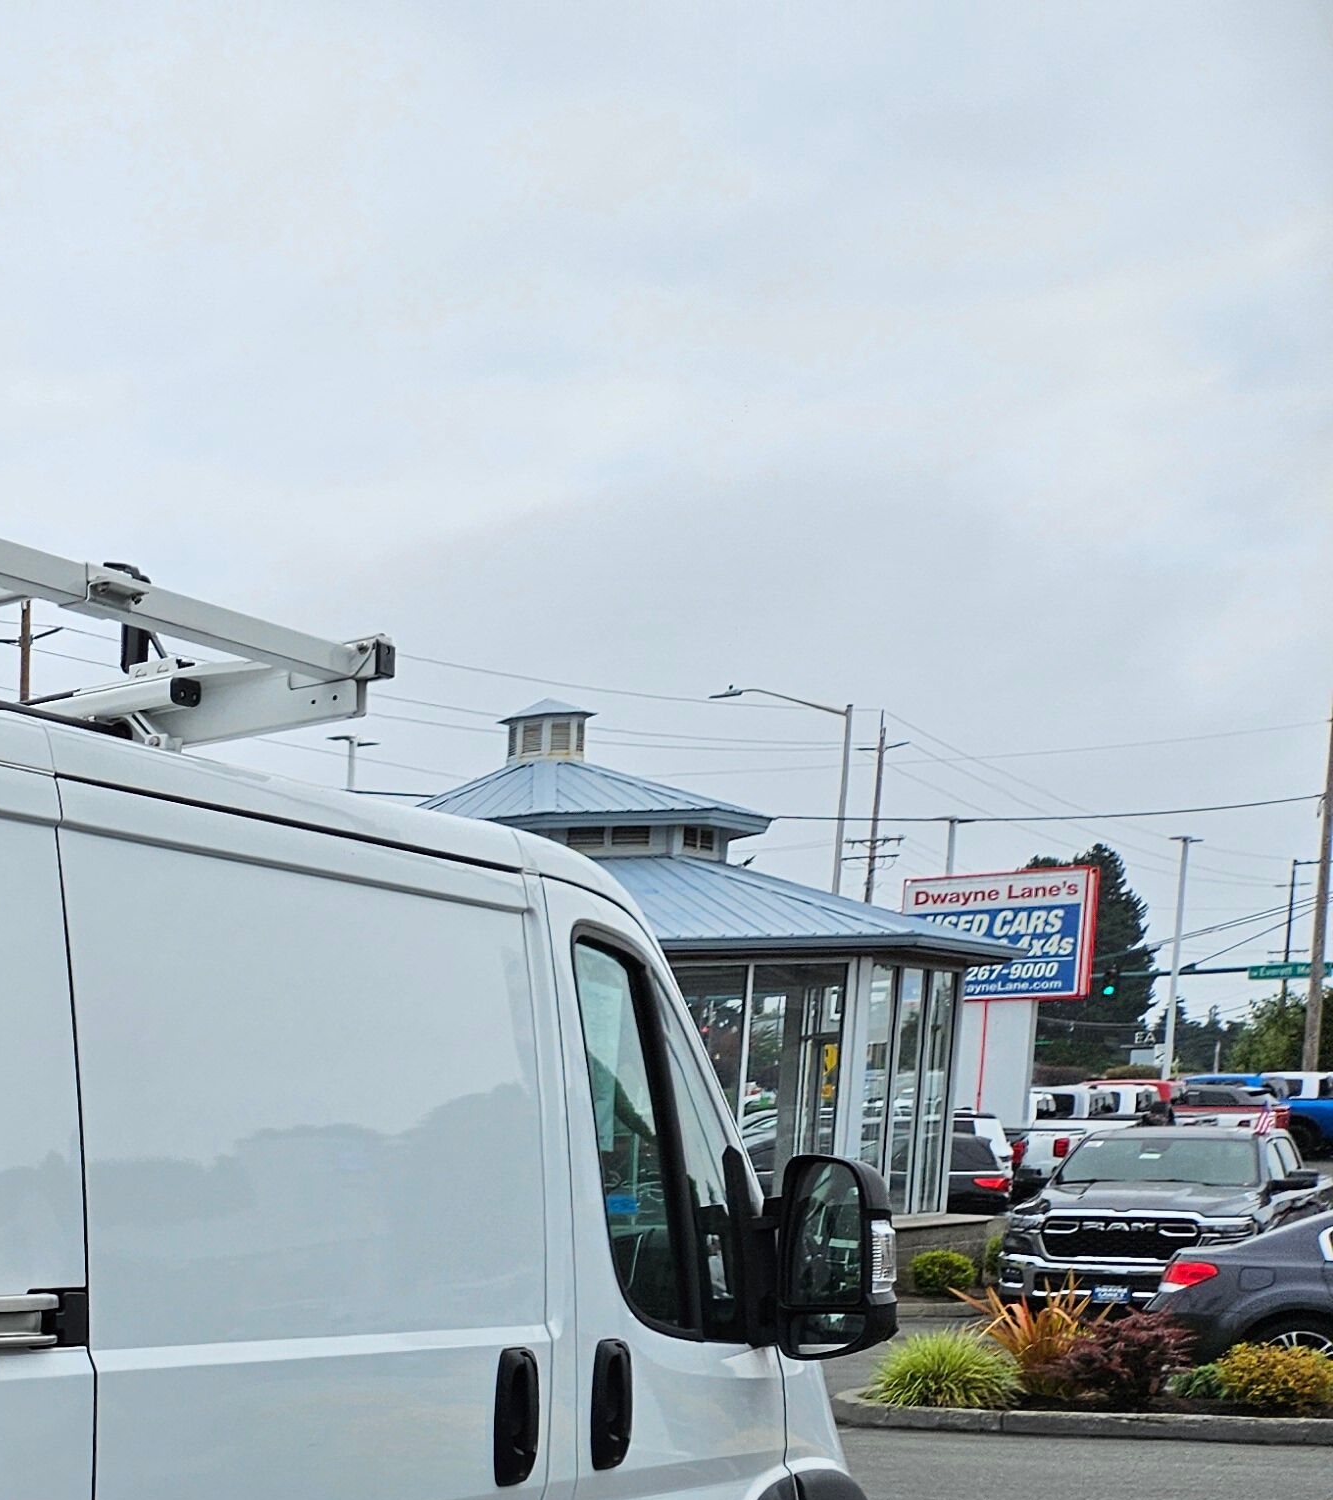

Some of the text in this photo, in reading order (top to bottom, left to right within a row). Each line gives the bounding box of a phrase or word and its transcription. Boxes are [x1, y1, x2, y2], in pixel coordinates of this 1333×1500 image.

[914, 881, 1079, 906] Dwayne Lane's
[993, 908, 1065, 937] CARS
[965, 962, 1059, 981] 267-9000
[965, 980, 1062, 994] ayneLane.com
[1083, 1221, 1157, 1232] RAM
